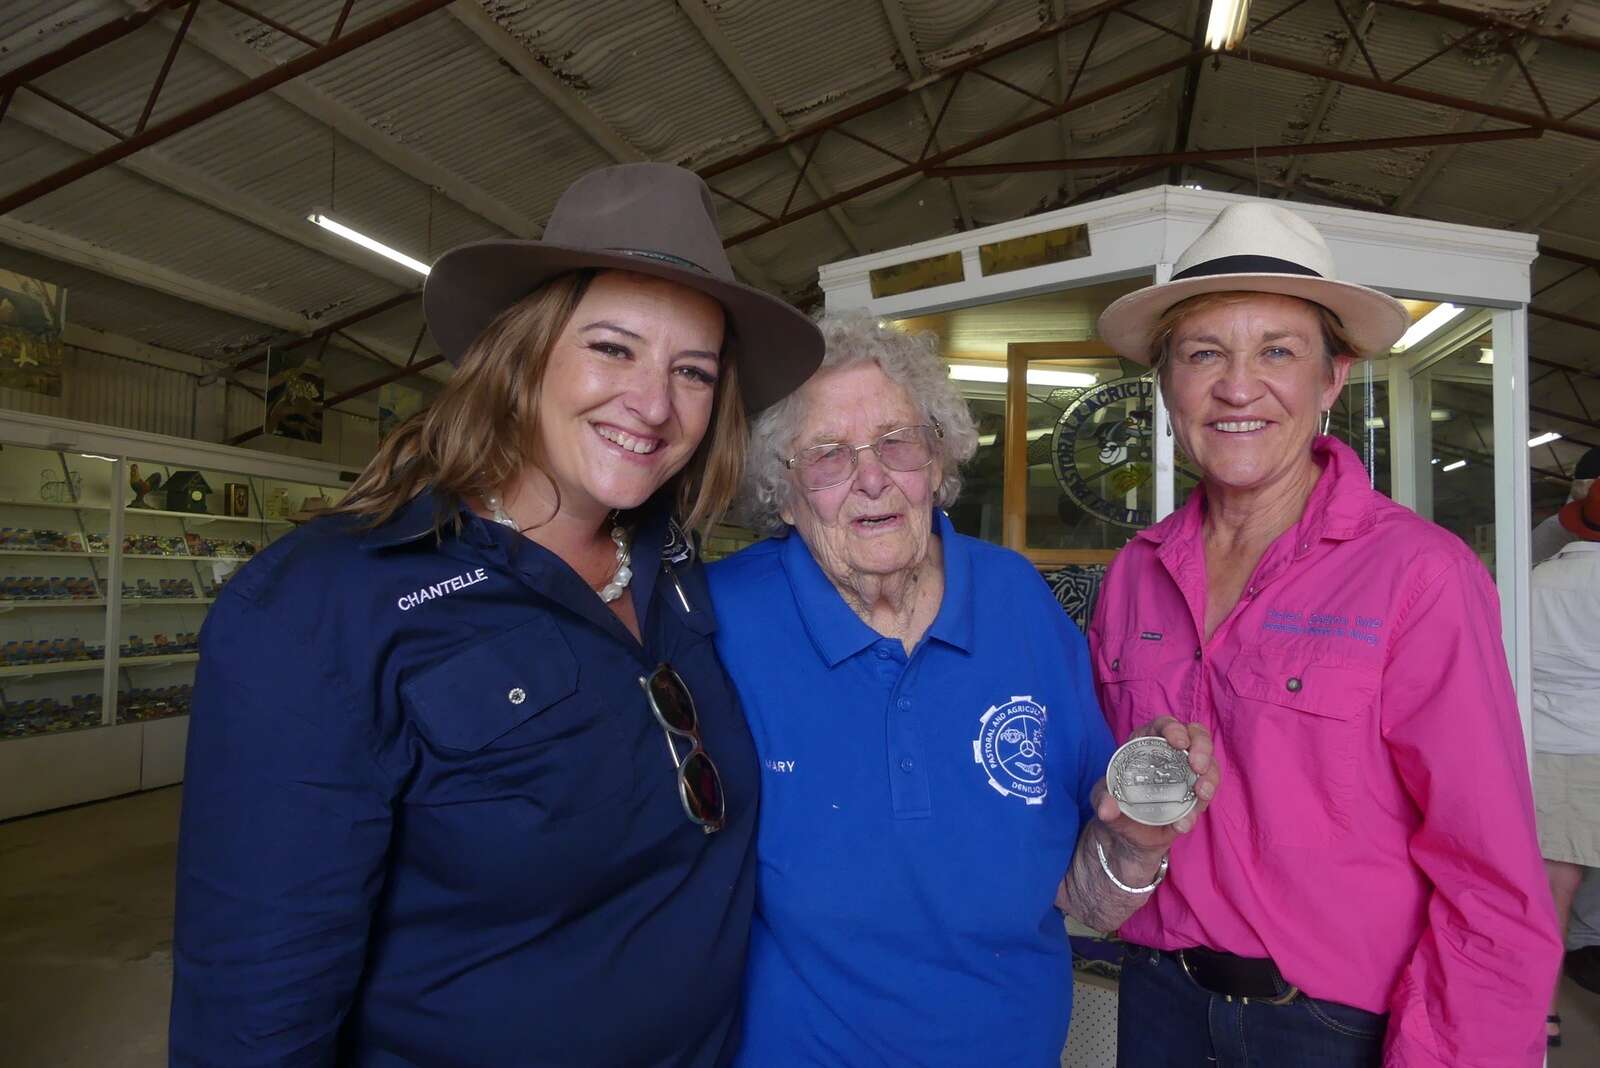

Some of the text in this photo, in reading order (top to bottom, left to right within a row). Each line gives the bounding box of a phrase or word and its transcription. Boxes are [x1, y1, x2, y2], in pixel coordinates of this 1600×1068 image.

[398, 568, 489, 611] CHANTELLE
[985, 728, 998, 769] PASTORAL
[992, 712, 1006, 728] AND
